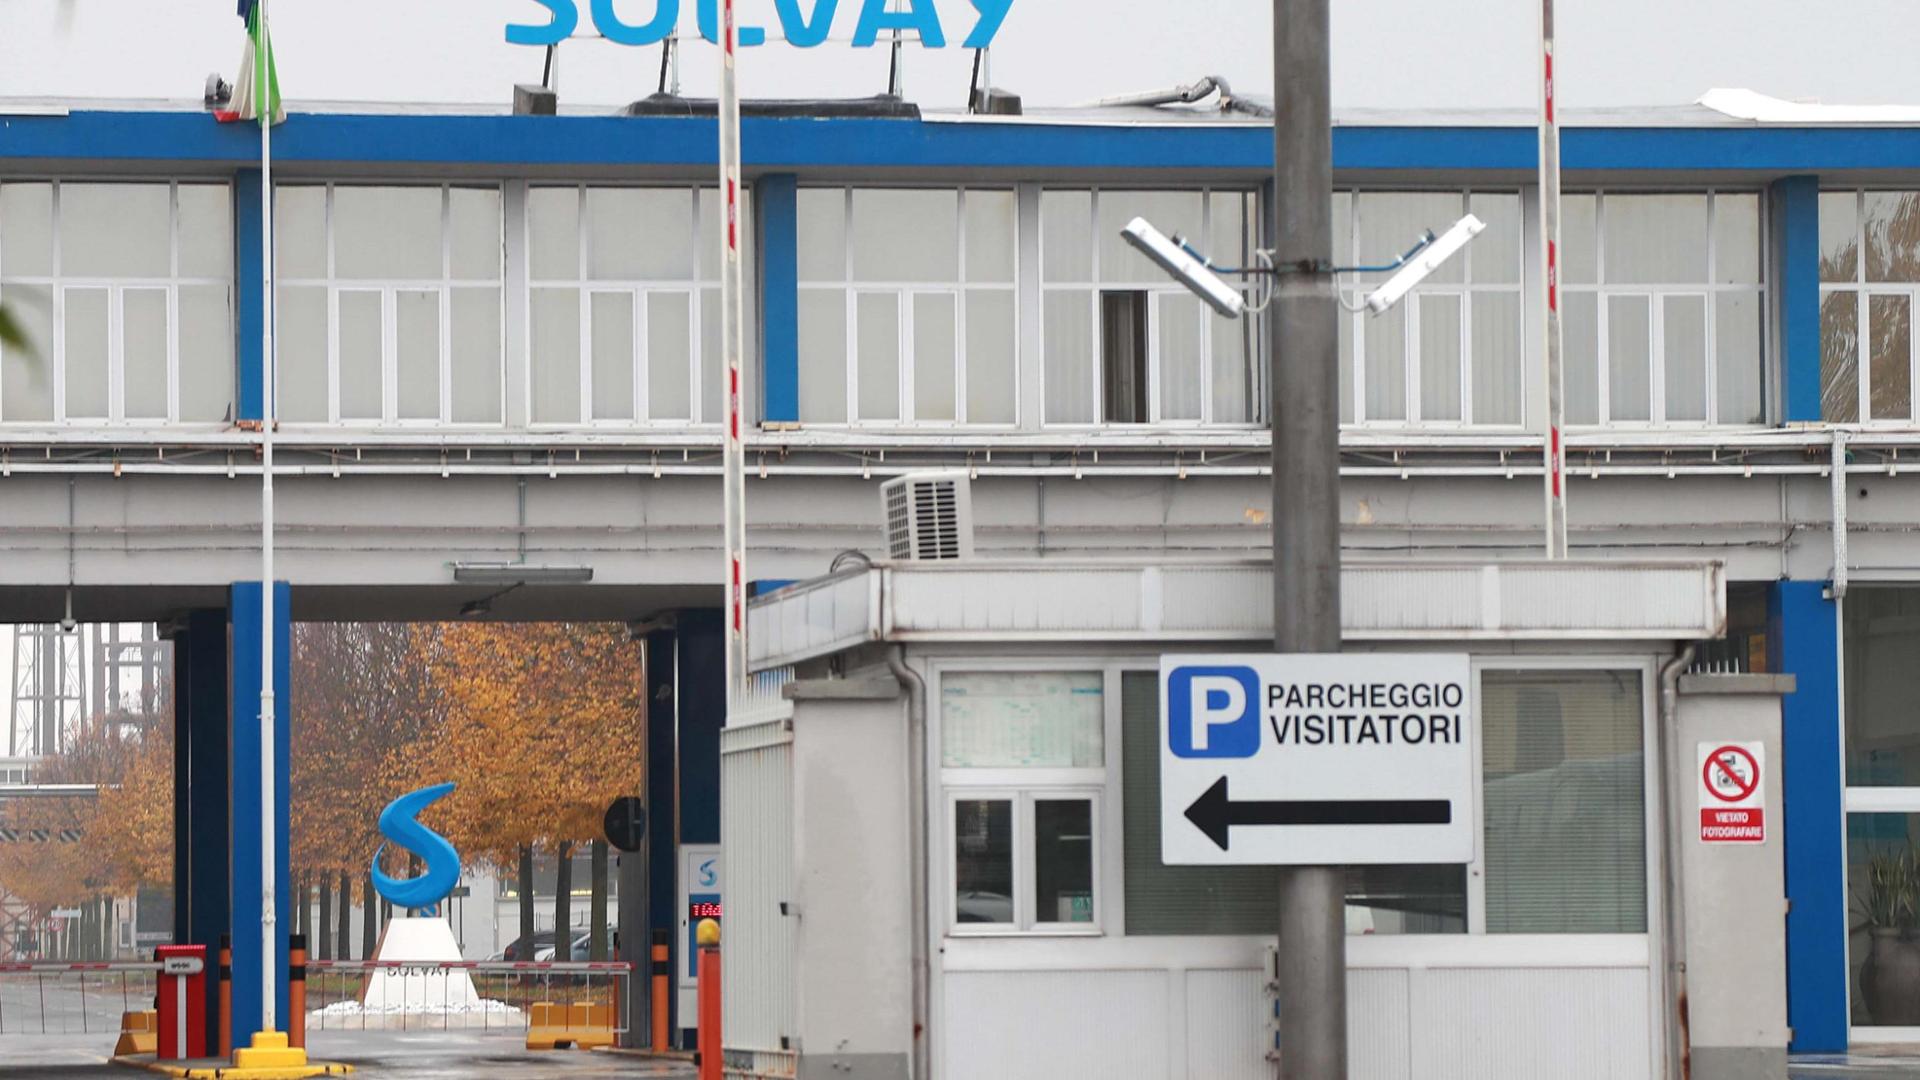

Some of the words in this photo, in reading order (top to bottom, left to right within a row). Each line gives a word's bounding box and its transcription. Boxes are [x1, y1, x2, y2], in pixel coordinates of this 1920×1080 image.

[1268, 683, 1462, 708] PARCHEGGIO
[1190, 675, 1247, 750] P
[1270, 714, 1461, 744] VISITATORI
[1715, 812, 1749, 823] VIETATO
[1703, 826, 1762, 838] FOTOGRAFARE
